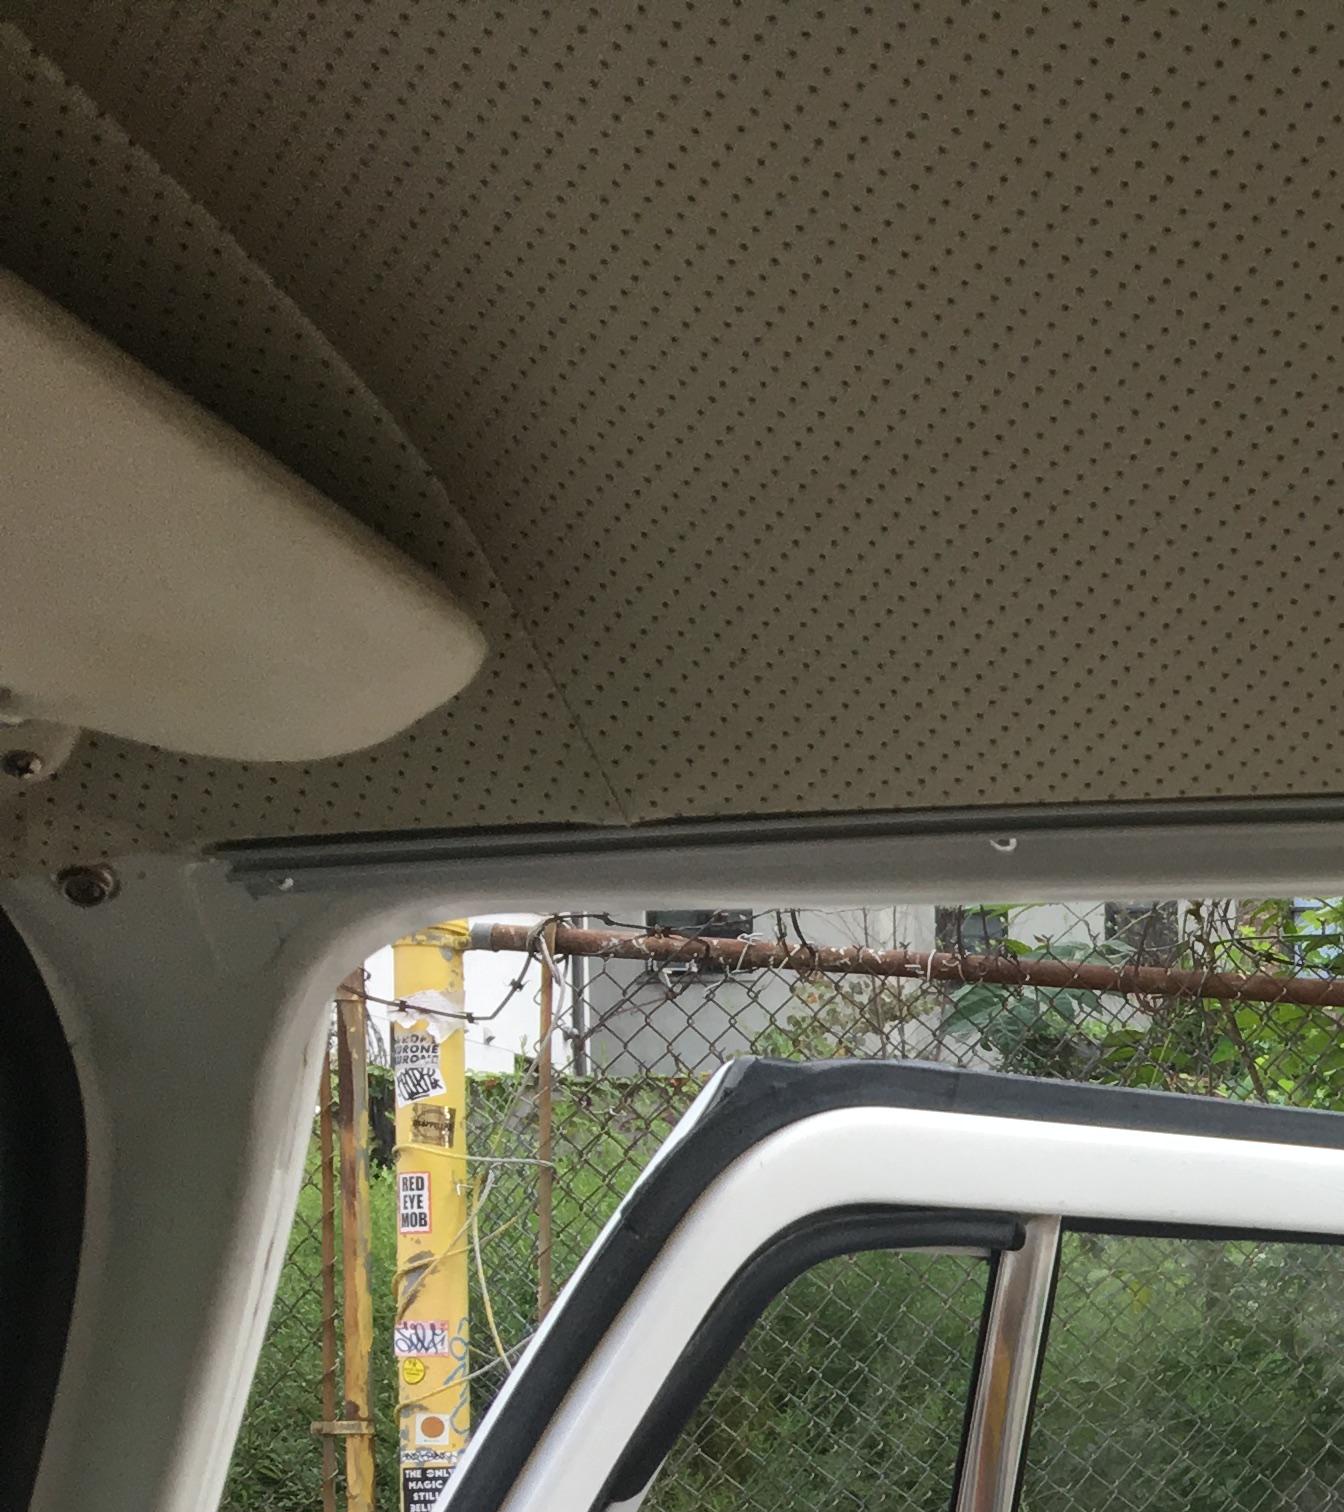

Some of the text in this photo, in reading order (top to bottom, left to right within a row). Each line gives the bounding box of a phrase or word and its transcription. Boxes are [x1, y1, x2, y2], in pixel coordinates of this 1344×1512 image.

[402, 1176, 425, 1191] RED
[403, 1194, 424, 1210] EYE
[401, 1212, 428, 1228] MOB
[405, 1469, 422, 1478] THE
[408, 1480, 443, 1490] MAGIC
[410, 1503, 431, 1512] BELI
